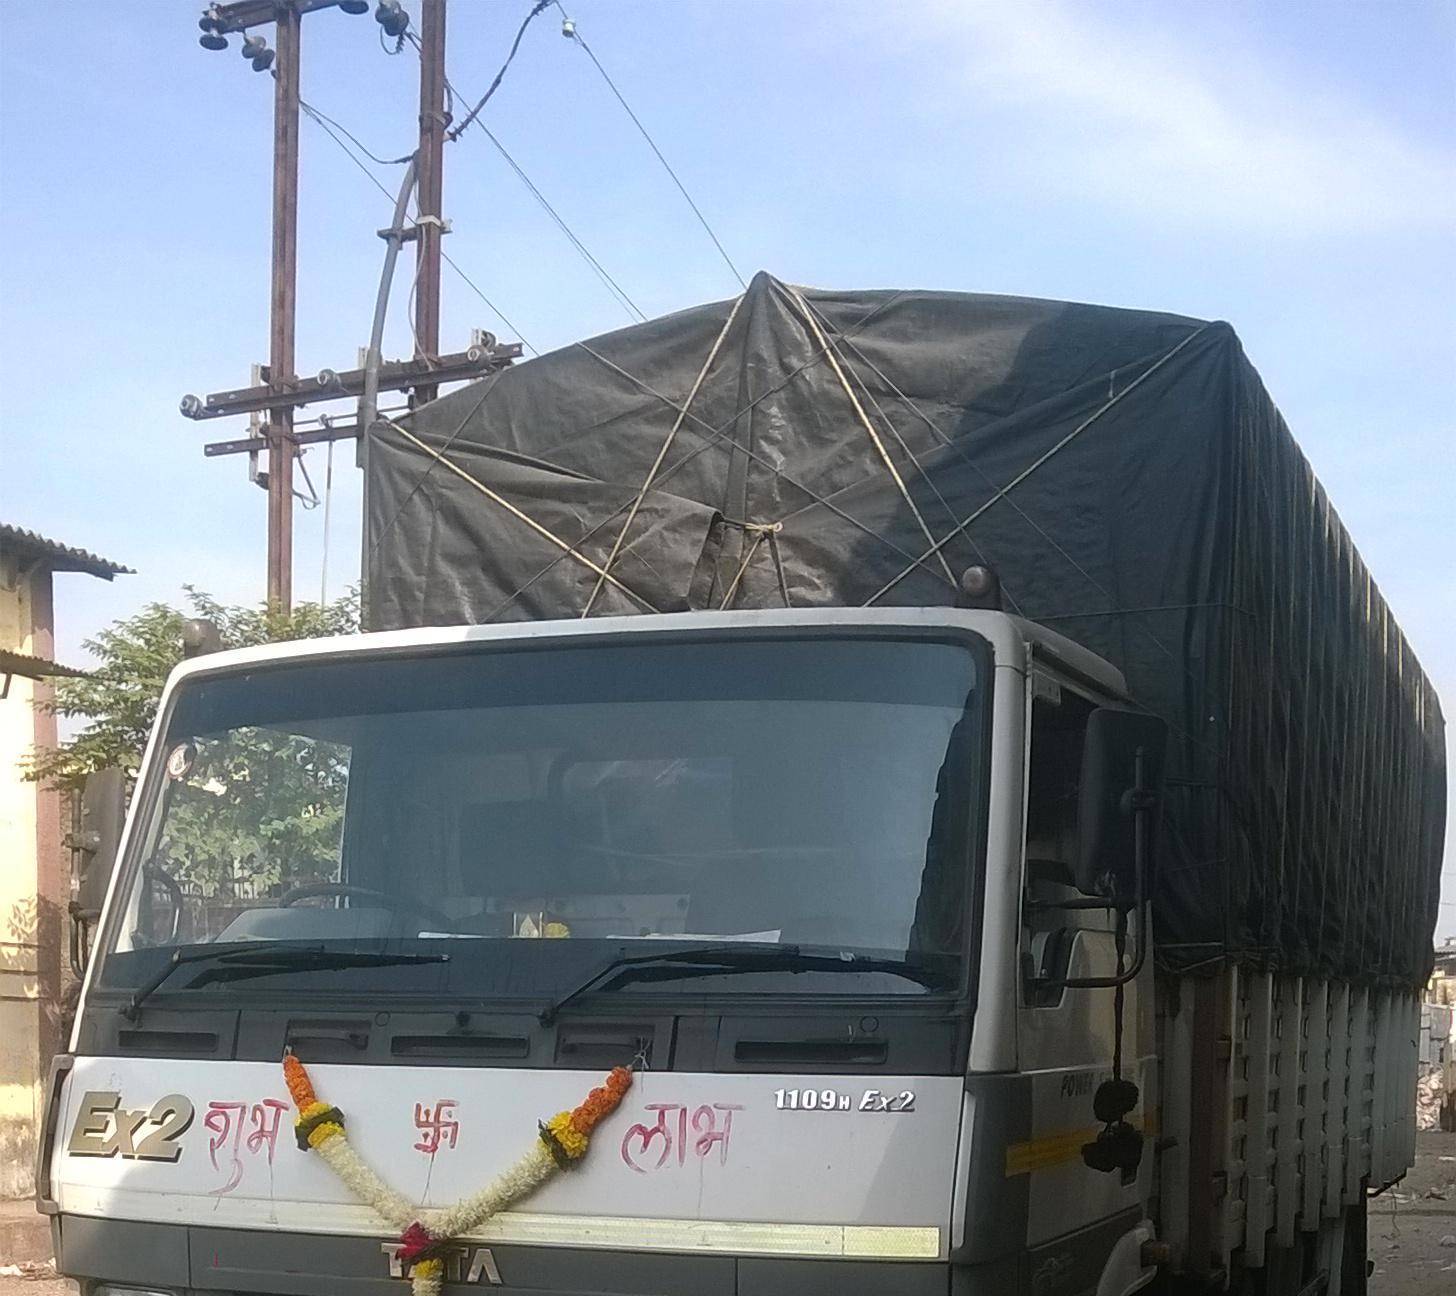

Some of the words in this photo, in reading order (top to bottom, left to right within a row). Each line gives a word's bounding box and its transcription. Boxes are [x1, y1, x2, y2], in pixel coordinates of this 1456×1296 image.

[68, 1091, 195, 1163] Ex2
[858, 1089, 916, 1112] Ex2
[204, 1099, 290, 1196] शुभ
[620, 1102, 746, 1173] लाभ
[381, 1242, 503, 1285] TTA
